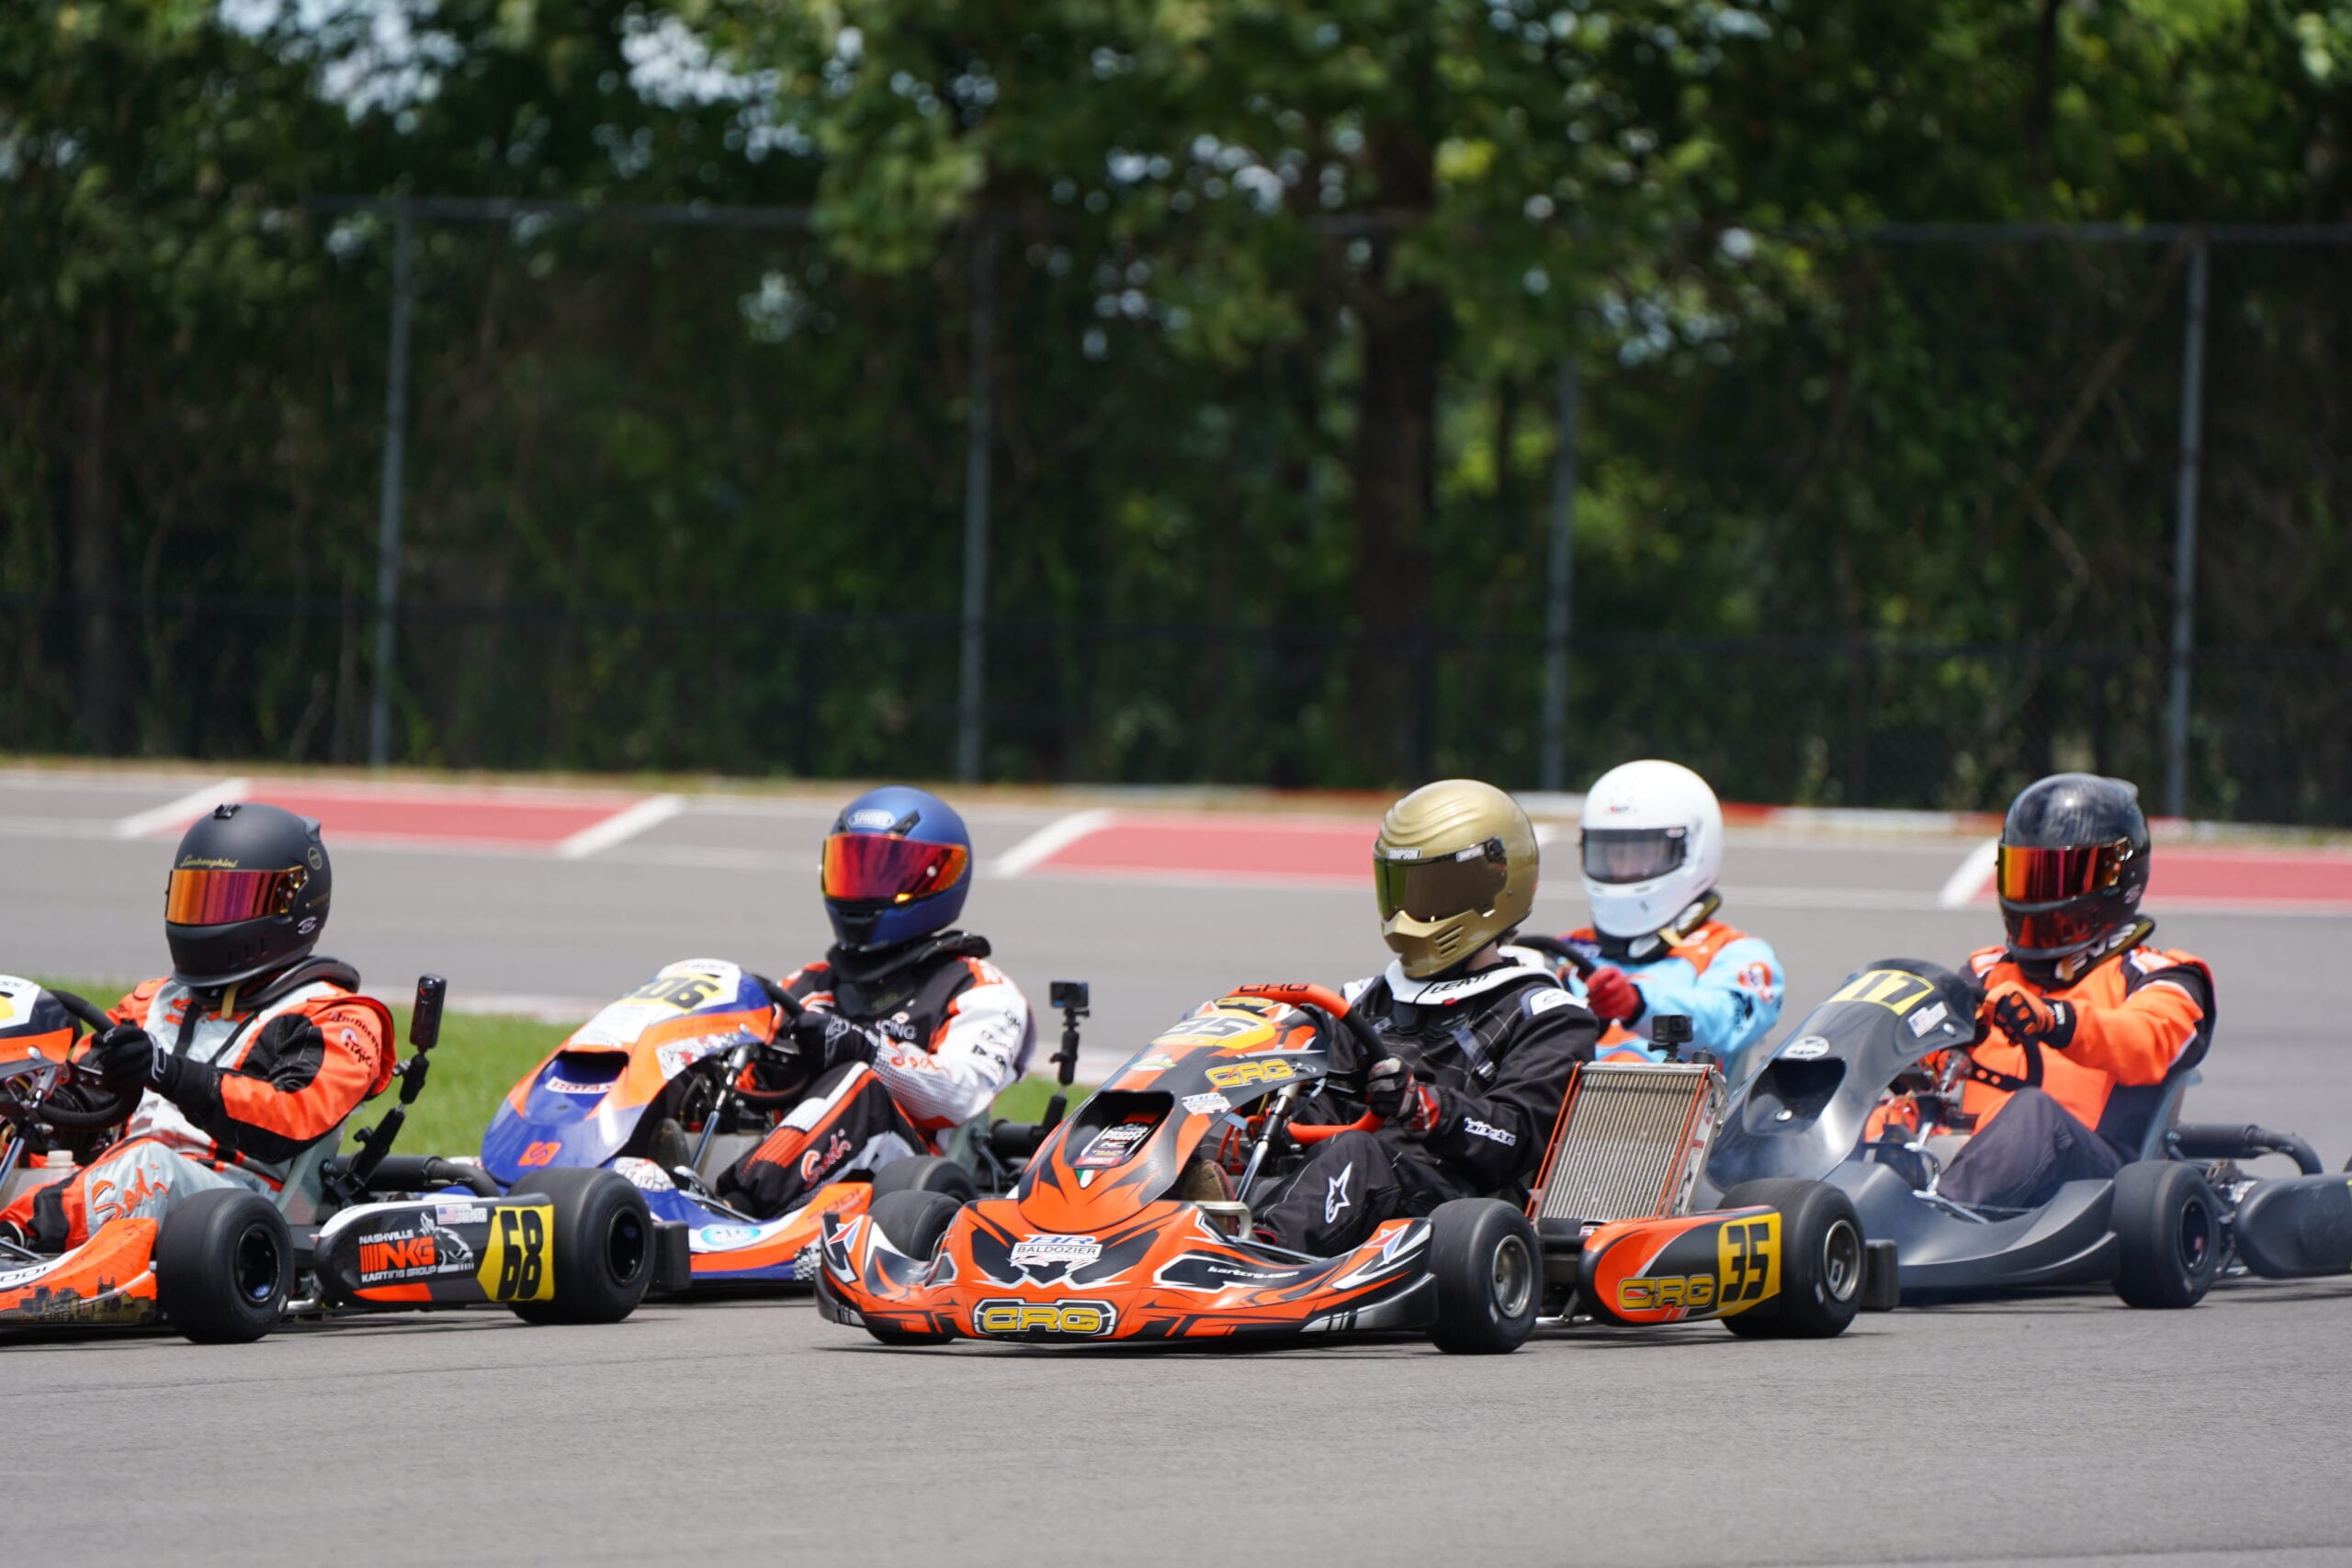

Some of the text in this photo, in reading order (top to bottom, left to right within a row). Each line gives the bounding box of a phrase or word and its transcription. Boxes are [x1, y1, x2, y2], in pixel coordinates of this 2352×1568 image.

[1205, 1058, 1296, 1089] CRG
[359, 1229, 414, 1245] NASHVILLE
[1017, 1247, 1096, 1255] BALDOZIER
[497, 1210, 544, 1300] 68
[1721, 1223, 1770, 1303] 35
[406, 1265, 436, 1279] GROUP
[1619, 1275, 1715, 1312] CRG
[984, 1307, 1102, 1332] CRG
